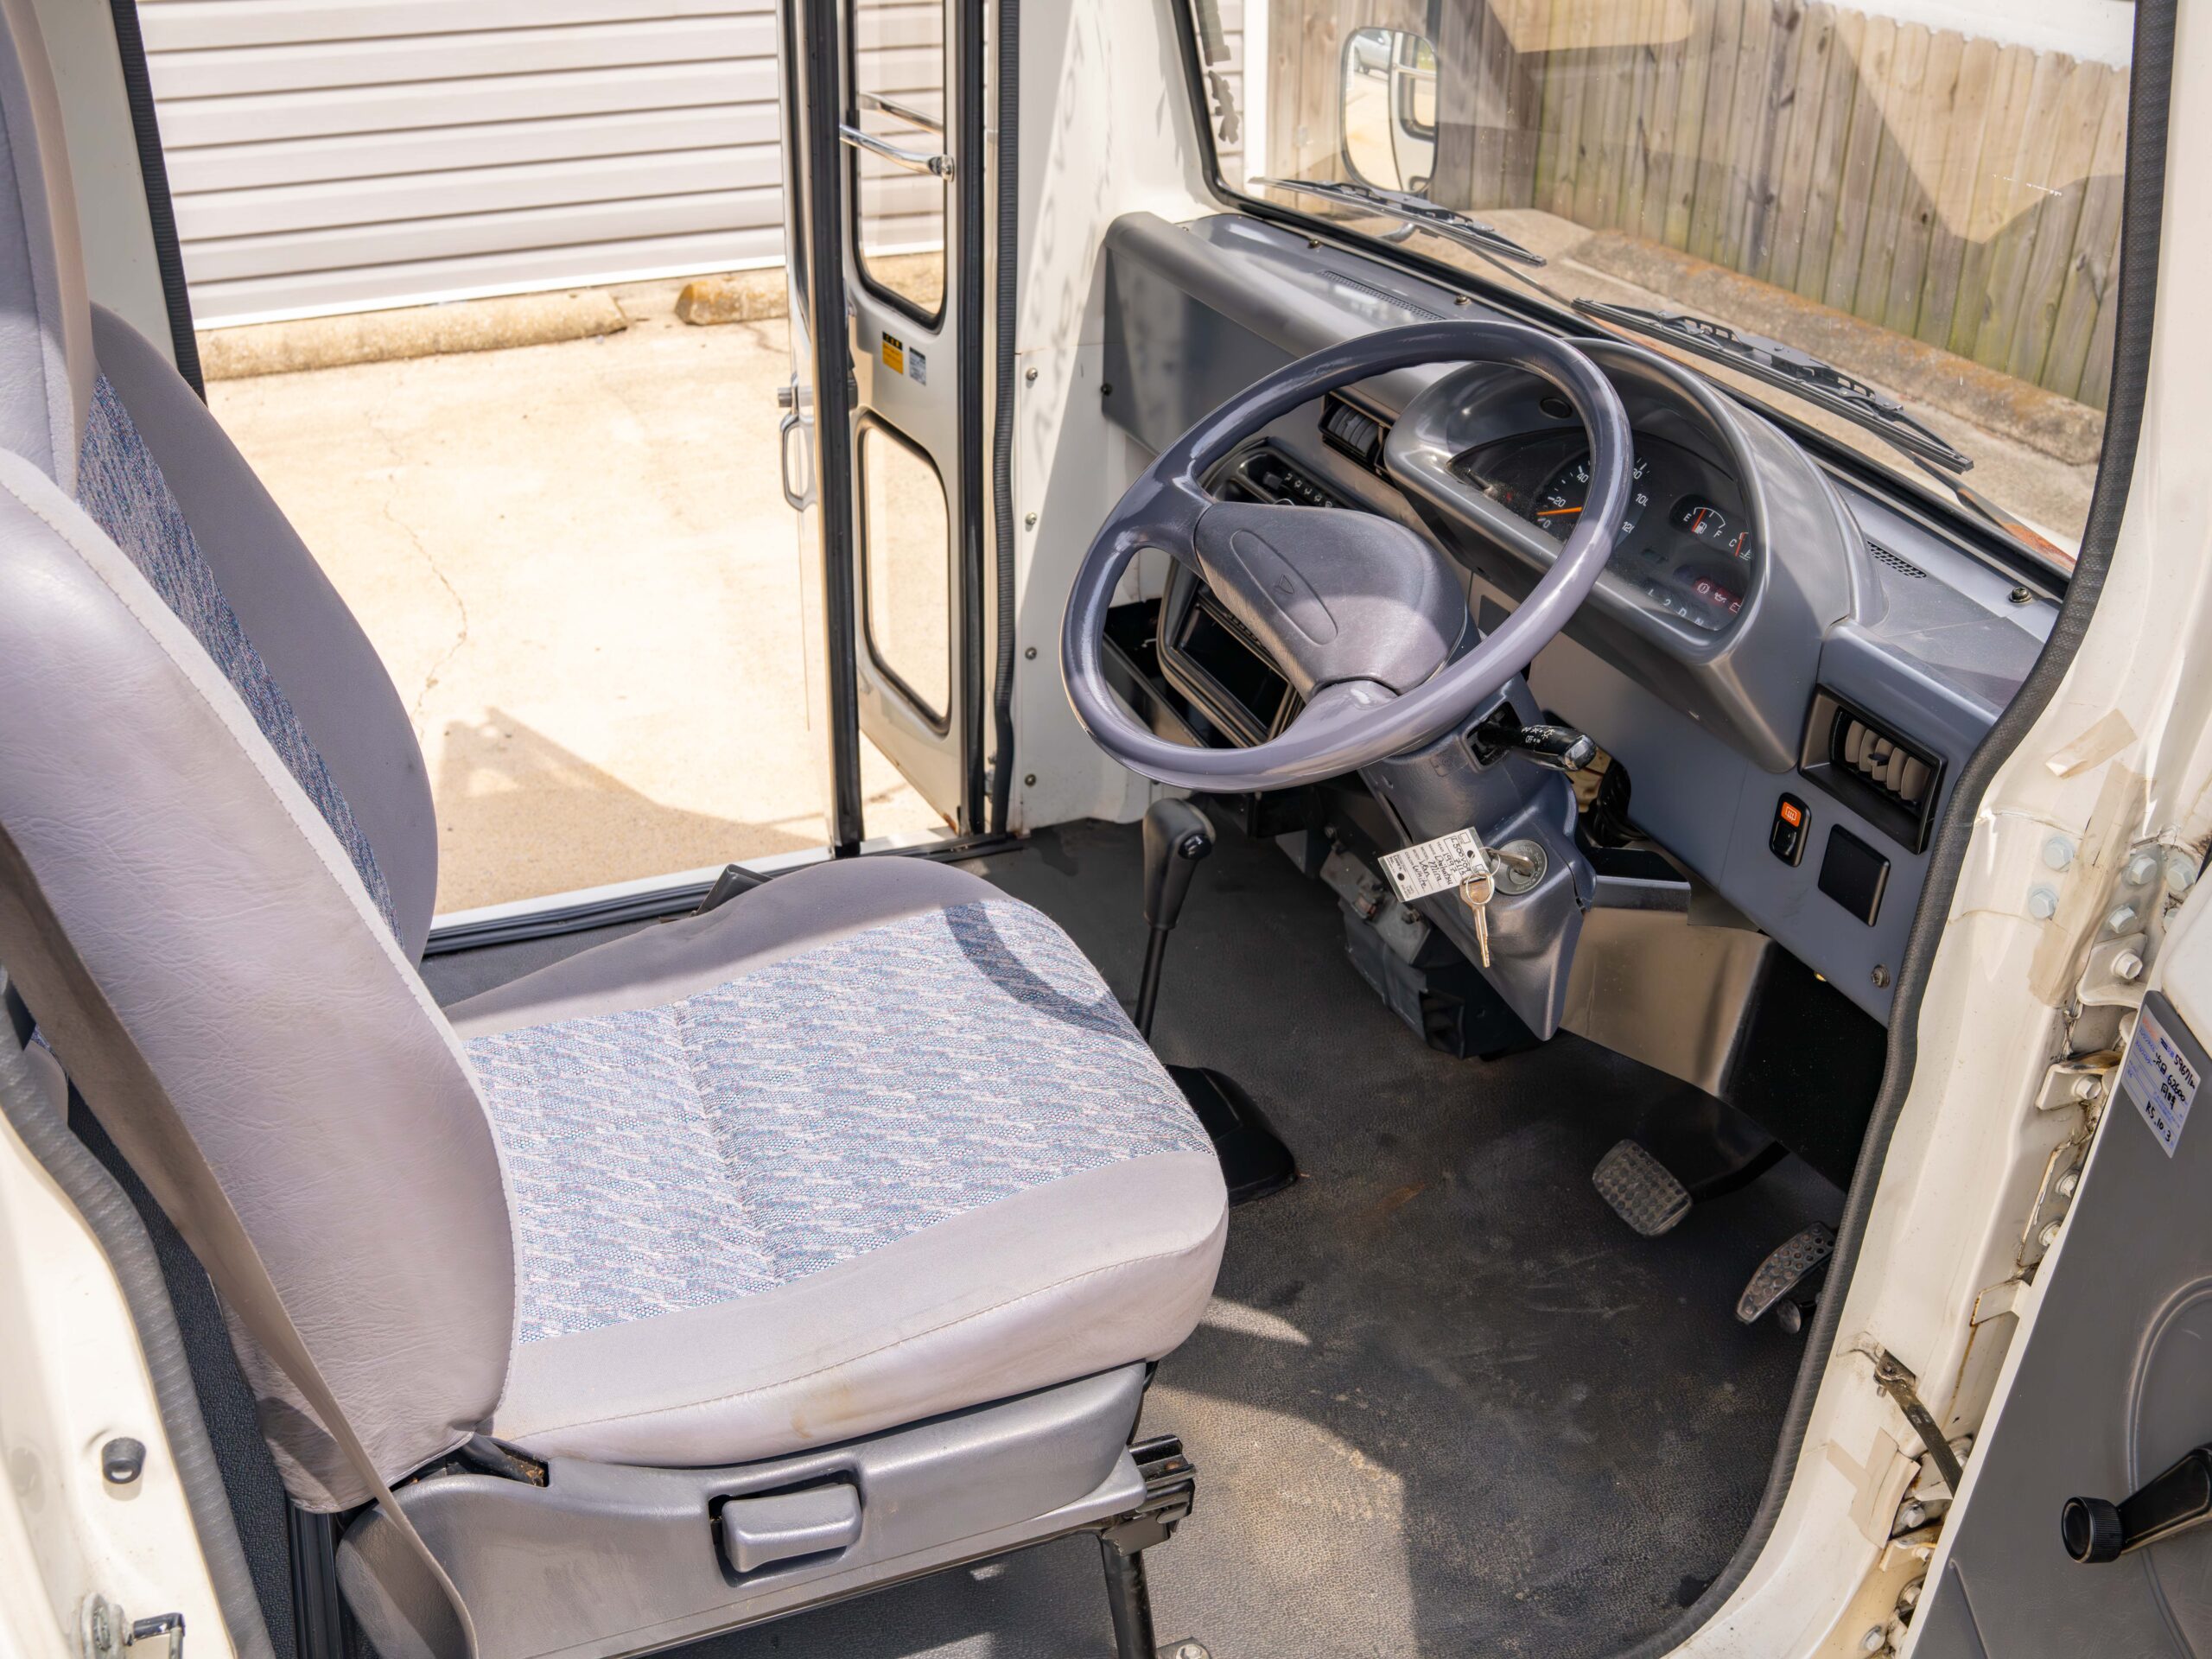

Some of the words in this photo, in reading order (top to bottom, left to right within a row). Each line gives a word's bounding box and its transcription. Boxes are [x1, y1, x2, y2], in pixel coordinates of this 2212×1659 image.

[1576, 472, 1589, 483] 40
[1553, 496, 1567, 508] 20
[1683, 512, 1693, 522] E
[1542, 519, 1551, 529] 0
[1713, 530, 1723, 538] F
[1728, 538, 1738, 548] C
[1677, 607, 1688, 618] D
[1443, 852, 1459, 872] 1997
